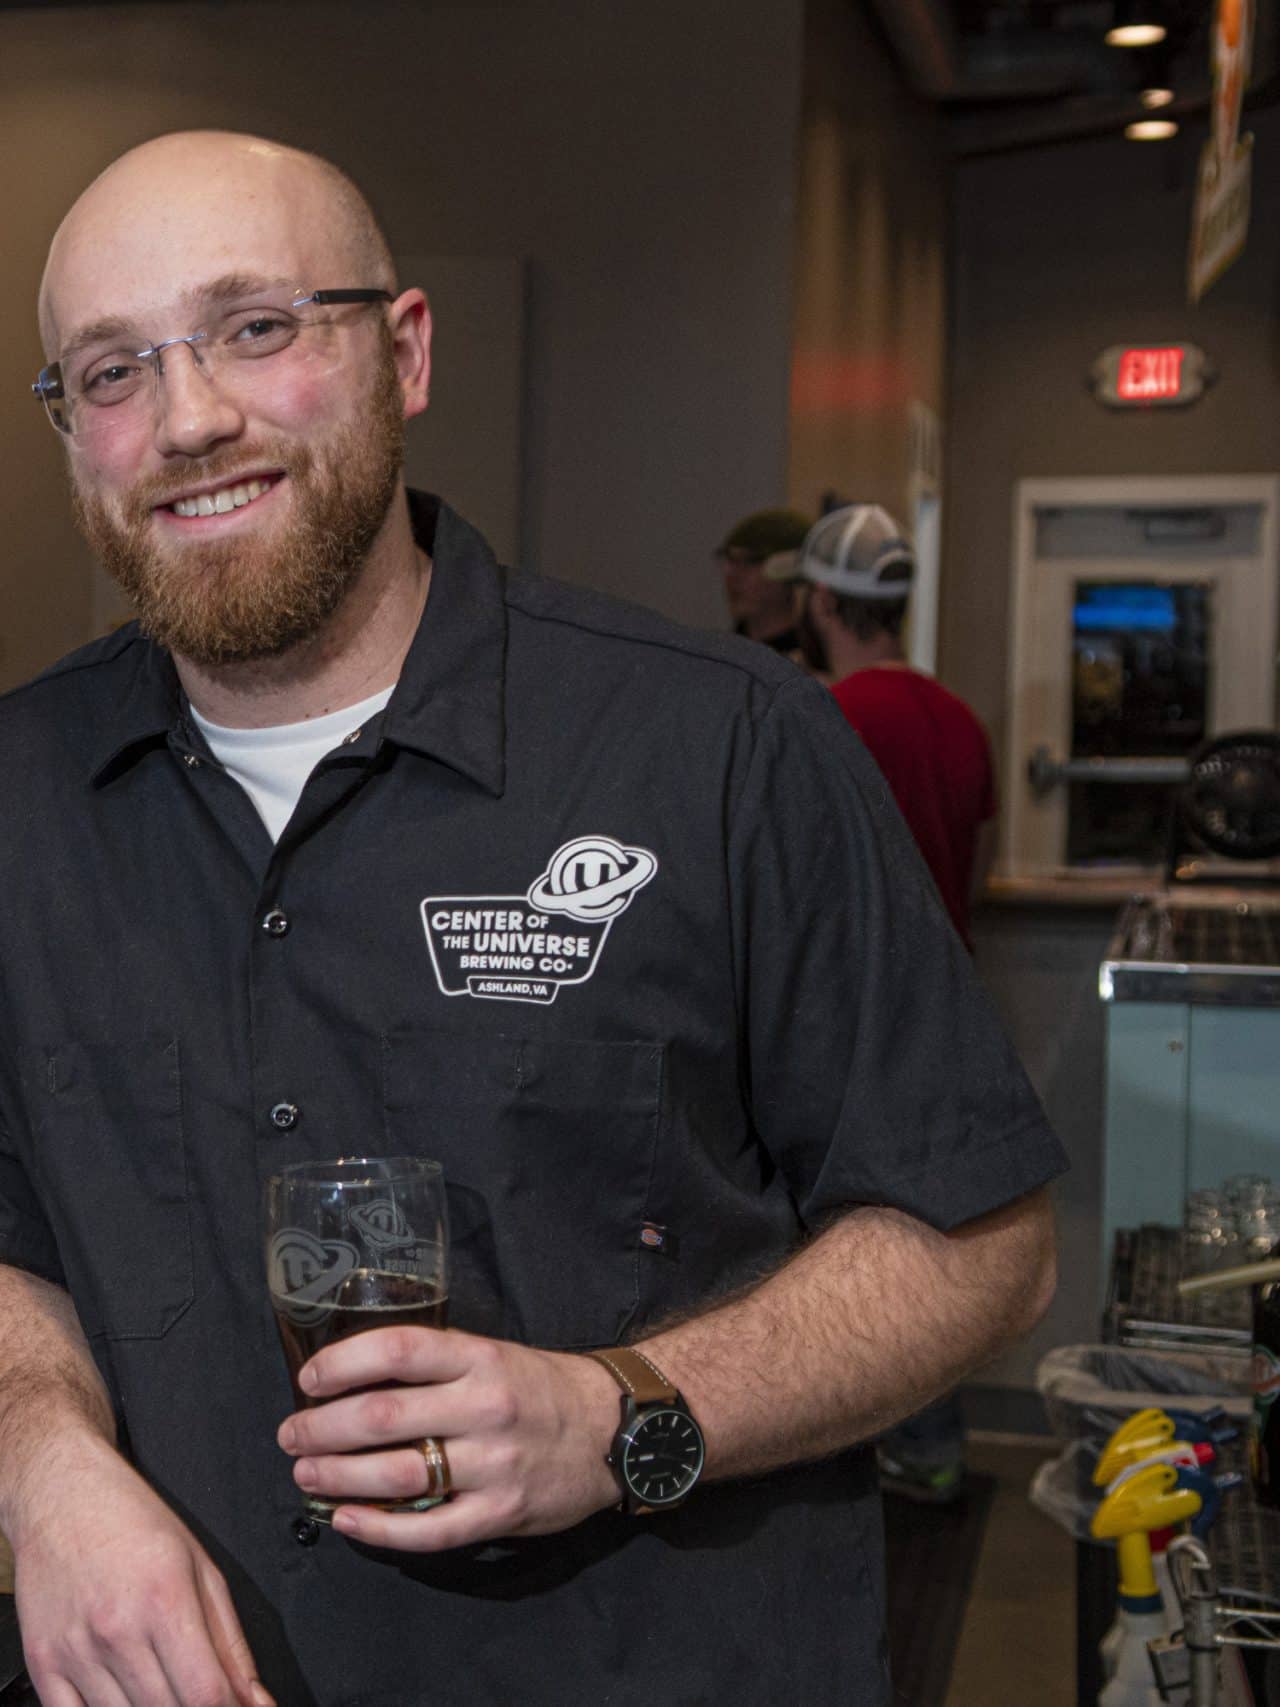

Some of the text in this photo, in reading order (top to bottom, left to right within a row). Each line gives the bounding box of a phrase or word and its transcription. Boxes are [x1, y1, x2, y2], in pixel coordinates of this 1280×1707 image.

[1123, 349, 1181, 394] EXIT
[431, 910, 549, 931] CENTER OF
[442, 932, 590, 957] THE UNIVERSE
[460, 955, 534, 970] BREWING
